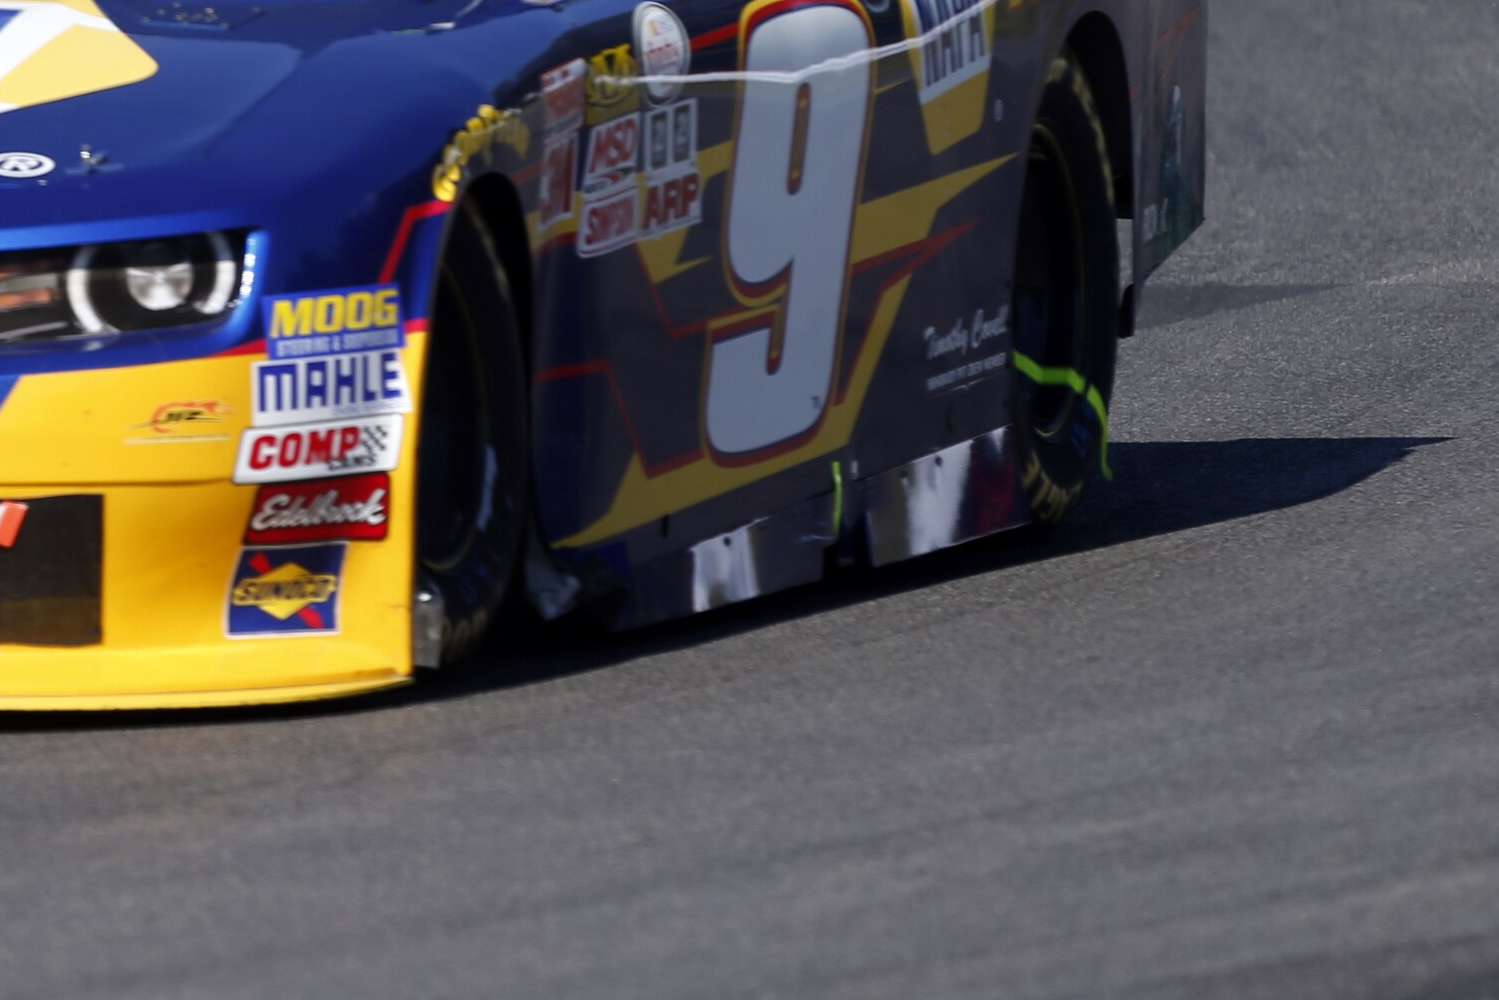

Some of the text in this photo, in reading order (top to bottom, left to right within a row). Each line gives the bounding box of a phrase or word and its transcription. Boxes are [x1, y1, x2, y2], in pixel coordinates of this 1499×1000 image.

[588, 117, 637, 176] MSD
[642, 171, 701, 233] ARP
[270, 288, 399, 340] MOOG
[258, 351, 401, 413] MAHLE
[248, 426, 360, 471] COMP
[251, 488, 386, 532] Edelbrock
[233, 576, 334, 602] SUNOCO
